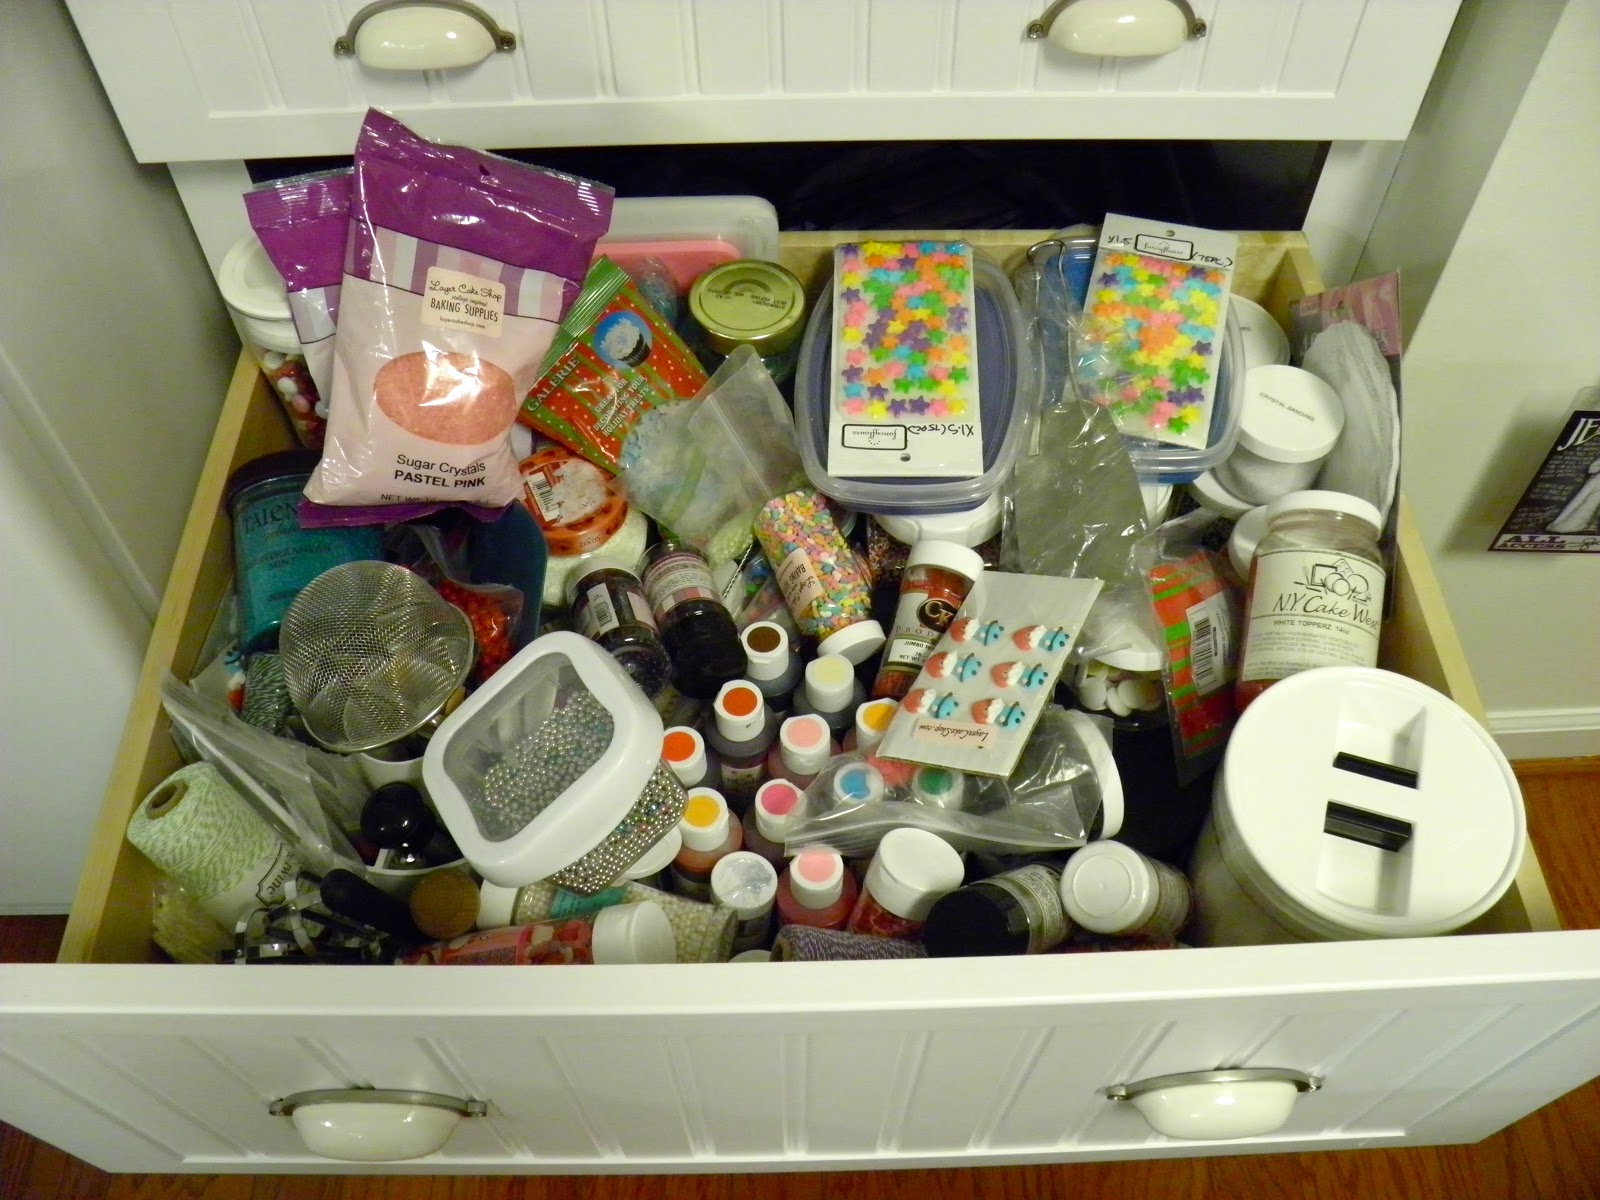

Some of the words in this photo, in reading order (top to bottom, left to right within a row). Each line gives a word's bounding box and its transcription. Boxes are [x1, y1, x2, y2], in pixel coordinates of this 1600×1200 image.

[429, 280, 456, 296] Layer
[457, 283, 479, 296] Cake
[480, 287, 503, 303] Shop
[430, 297, 461, 313] BAKING
[464, 303, 499, 322] SUPPLIES
[439, 315, 486, 329] layercakeshop.com
[527, 357, 580, 412] GALERIE
[614, 377, 629, 394] FOR
[592, 389, 632, 432] DECORATING
[1259, 391, 1286, 408] CRYSTAL
[1286, 405, 1316, 422] SANDING
[601, 409, 628, 437] HOLIDAY
[1557, 417, 1600, 451] JE
[396, 453, 436, 471] Sugar
[439, 461, 486, 477] Crystals
[394, 469, 450, 488] PASTEL
[453, 476, 486, 488] PINK
[1497, 542, 1567, 550] ACCESS
[1504, 534, 1566, 544] ALL
[925, 600, 955, 626] CK
[1302, 595, 1351, 618] Cake
[1352, 602, 1379, 627] West
[895, 625, 934, 637] PROD
[1297, 620, 1332, 631] TOPPERZ
[904, 640, 924, 649] JUMBO
[918, 723, 989, 742] LayerCakeShop.com
